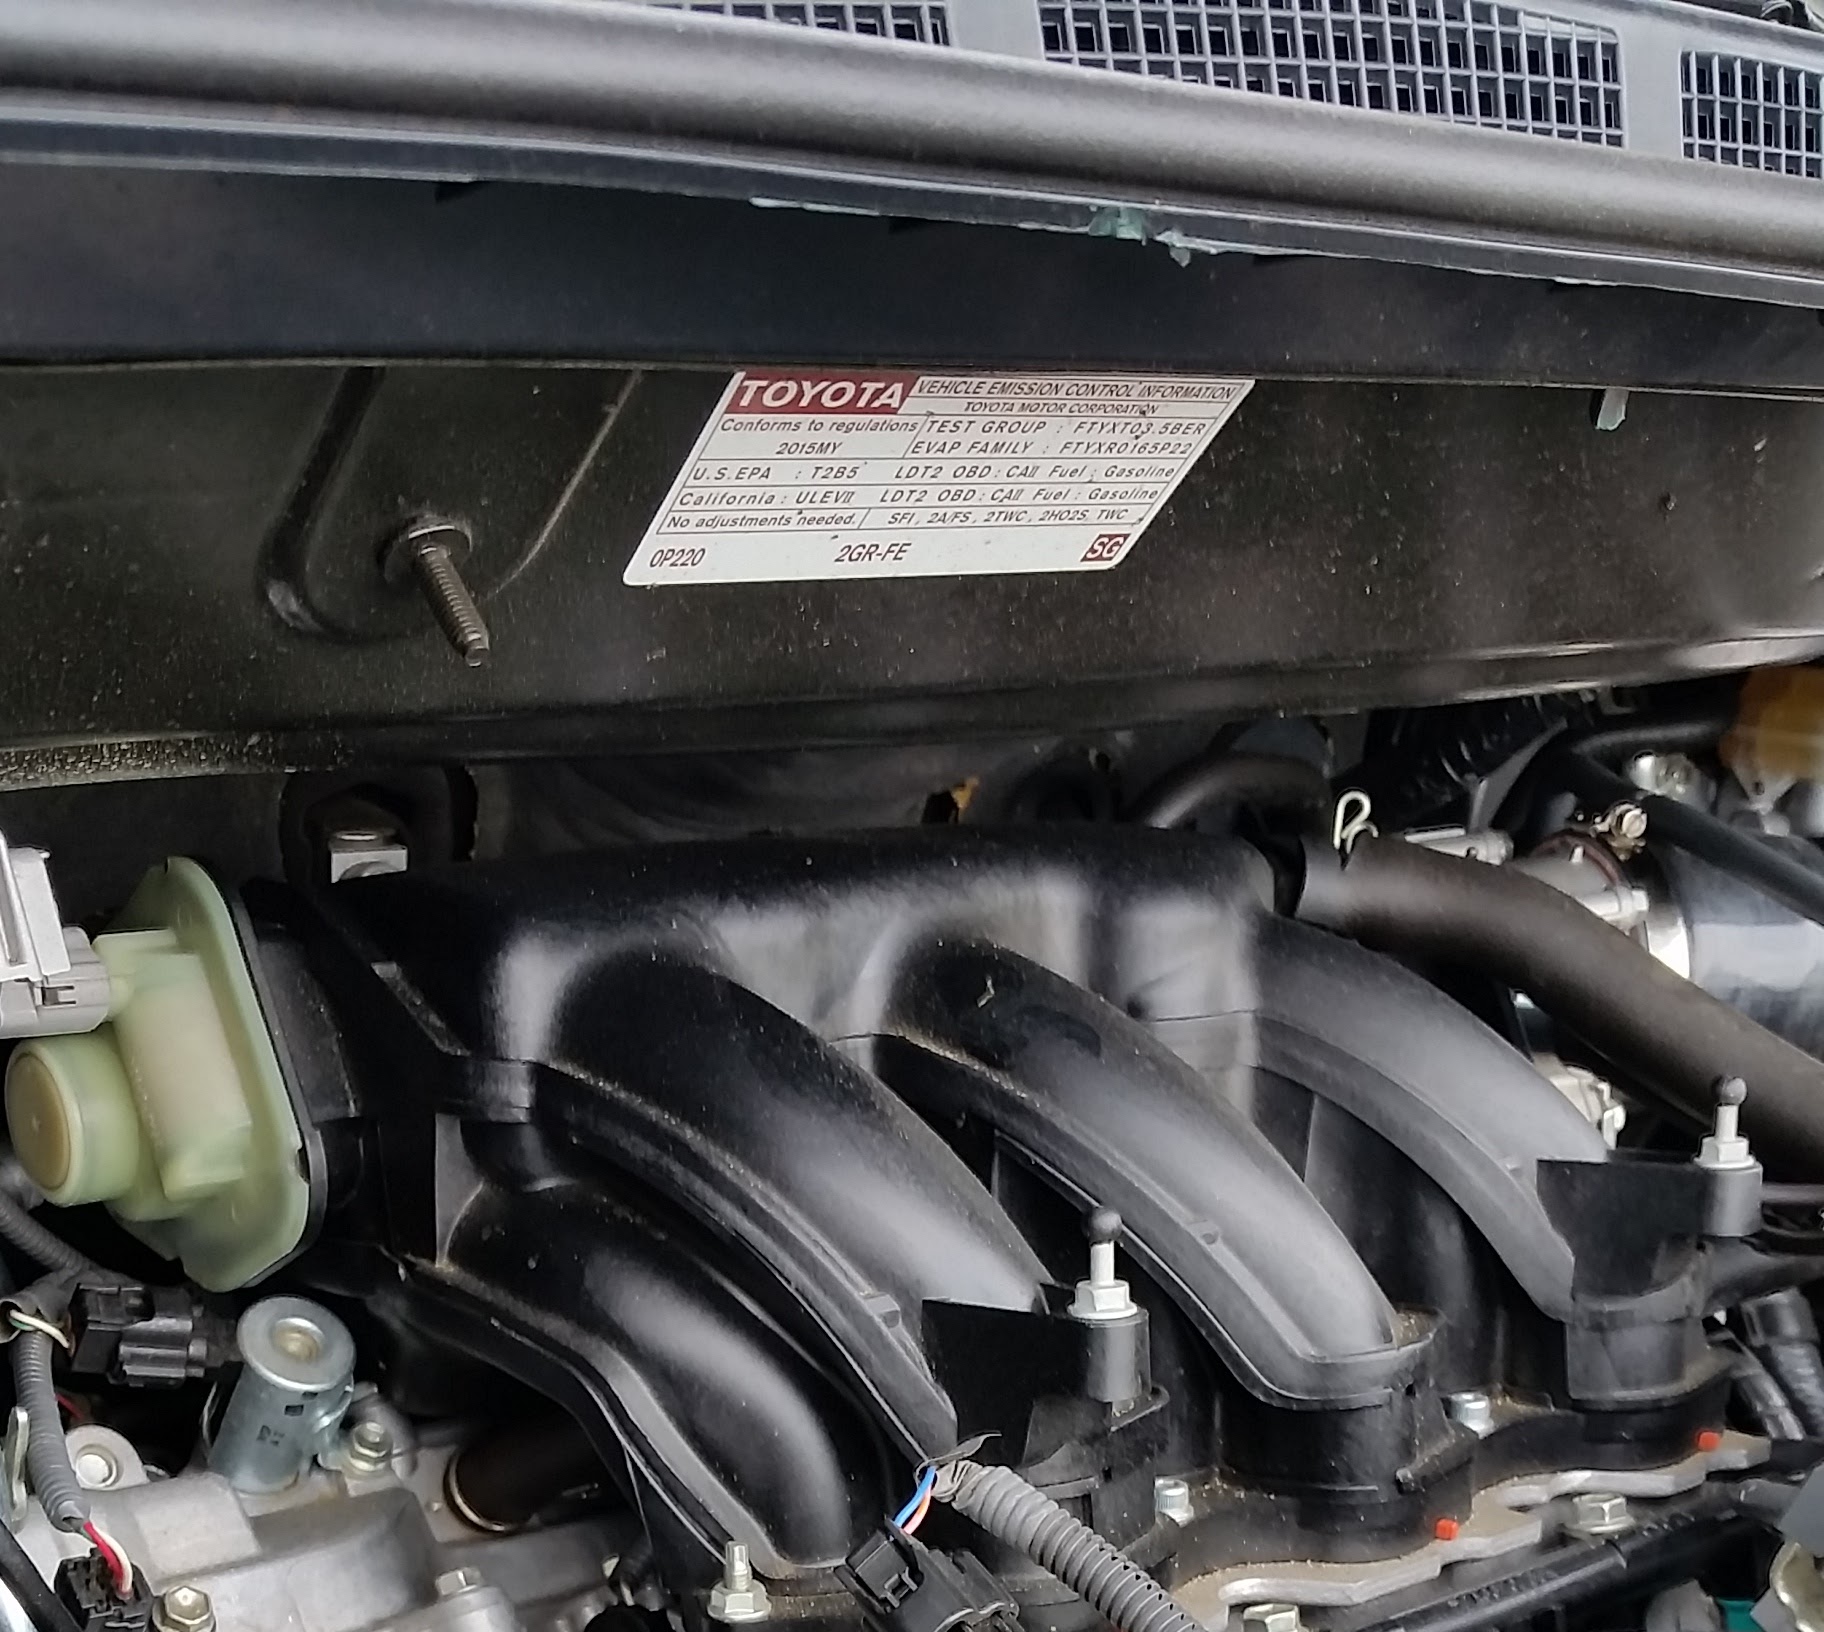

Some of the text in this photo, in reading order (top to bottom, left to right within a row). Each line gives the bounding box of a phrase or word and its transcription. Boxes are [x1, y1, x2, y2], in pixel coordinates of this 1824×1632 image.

[739, 380, 903, 409] TOYOTA
[917, 380, 1237, 399] VEHICLE EMISSION CONTROL INFORMATION
[964, 401, 1160, 416] TOYOTA MOTOR CORPORATION
[720, 418, 919, 434] Conforms to regulations
[926, 420, 976, 434] TEST
[981, 420, 1047, 434] GROUP
[775, 441, 843, 456] 2015MY
[911, 441, 962, 454] EVAP
[967, 441, 1034, 455] FAMILY
[810, 466, 860, 480] T2B5
[894, 465, 943, 479] LDT2
[1104, 465, 1175, 478] Gasoline
[880, 489, 928, 502] LDT2
[1088, 487, 1159, 500] Gasoline
[667, 513, 856, 530] No adjustments needed.
[1095, 508, 1129, 520] TWC
[834, 543, 912, 564] 2GR-FE
[1086, 536, 1125, 559] SG
